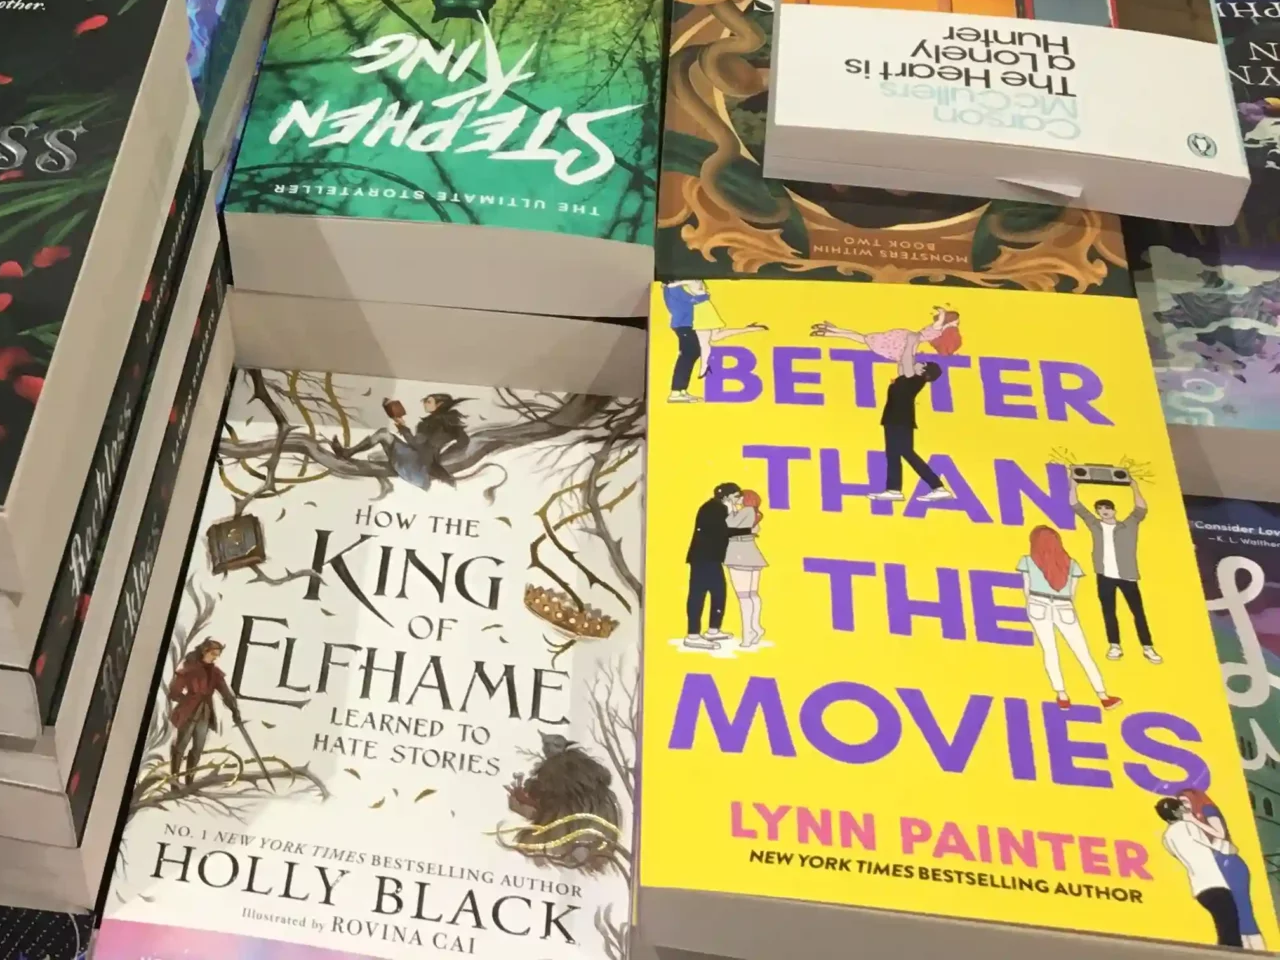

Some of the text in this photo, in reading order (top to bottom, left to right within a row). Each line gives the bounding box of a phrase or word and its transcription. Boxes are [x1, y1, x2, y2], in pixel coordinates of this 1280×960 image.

[350, 9, 536, 110] KING
[909, 37, 1076, 73] a Lonely
[940, 24, 1070, 55] Hunter
[842, 56, 1078, 98] The Heart is
[877, 79, 1080, 118] McCullers
[269, 95, 650, 186] STEPHEN
[930, 105, 1082, 141] Carson
[273, 182, 601, 216] THE ULTIMATE STORYTELLER
[811, 243, 967, 263] MONSTERS WITHIN
[842, 236, 935, 250] BOOK TWO
[704, 345, 1115, 426] BETTER
[742, 444, 1076, 531] THAN
[355, 504, 481, 539] HOW THE
[302, 528, 506, 628] KING
[803, 557, 1035, 647] THE
[407, 614, 458, 642] OF
[230, 615, 571, 727] ELFHAME
[329, 706, 492, 746] LEARNED TO
[668, 672, 1212, 795] MOVIES
[313, 732, 502, 778] HATE STORIES
[163, 822, 584, 900] NO. 1 NEW YORK TIMES BESTSELLING AUTHOR
[730, 800, 1154, 882] LYNN PAINTER
[148, 841, 582, 946] HOLLY BLACK
[749, 849, 1144, 905] NEW YORK TIMES BESTSELLING AUTHOR
[241, 906, 477, 955] Illustrated by ROVINA CAI
